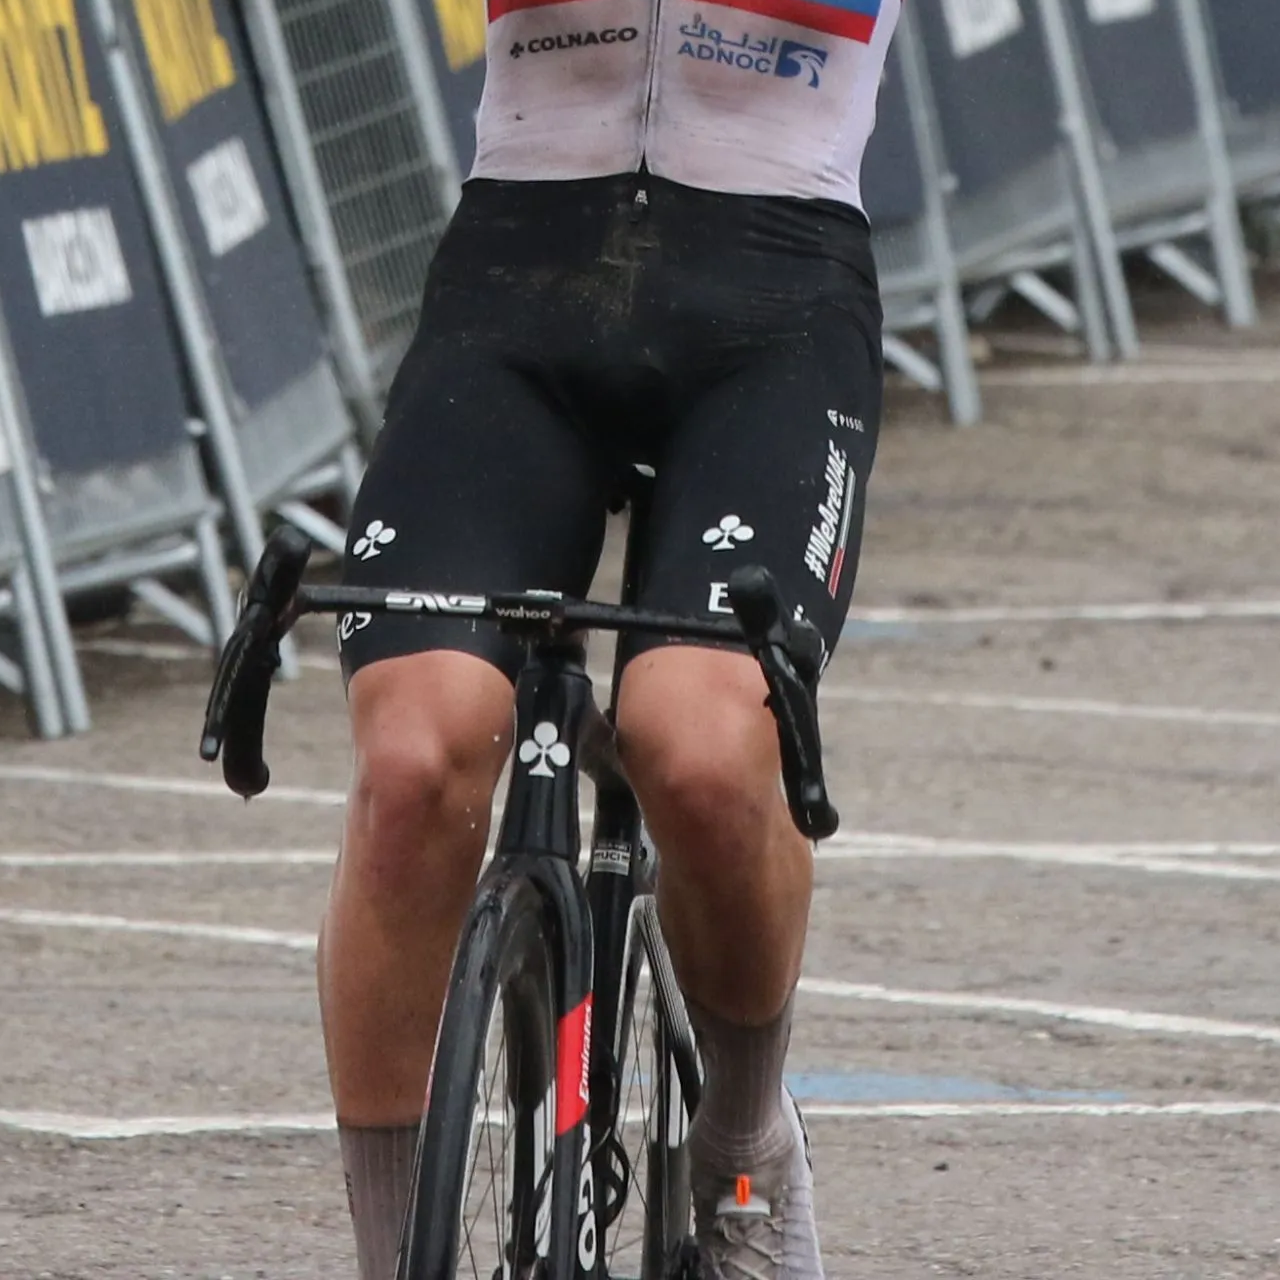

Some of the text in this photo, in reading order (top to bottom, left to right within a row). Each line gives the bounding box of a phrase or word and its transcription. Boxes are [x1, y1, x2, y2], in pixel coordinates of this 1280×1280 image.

[528, 26, 639, 55] COLNAGO
[678, 41, 772, 74] ADNOC
[578, 1003, 593, 1105] Emirates
